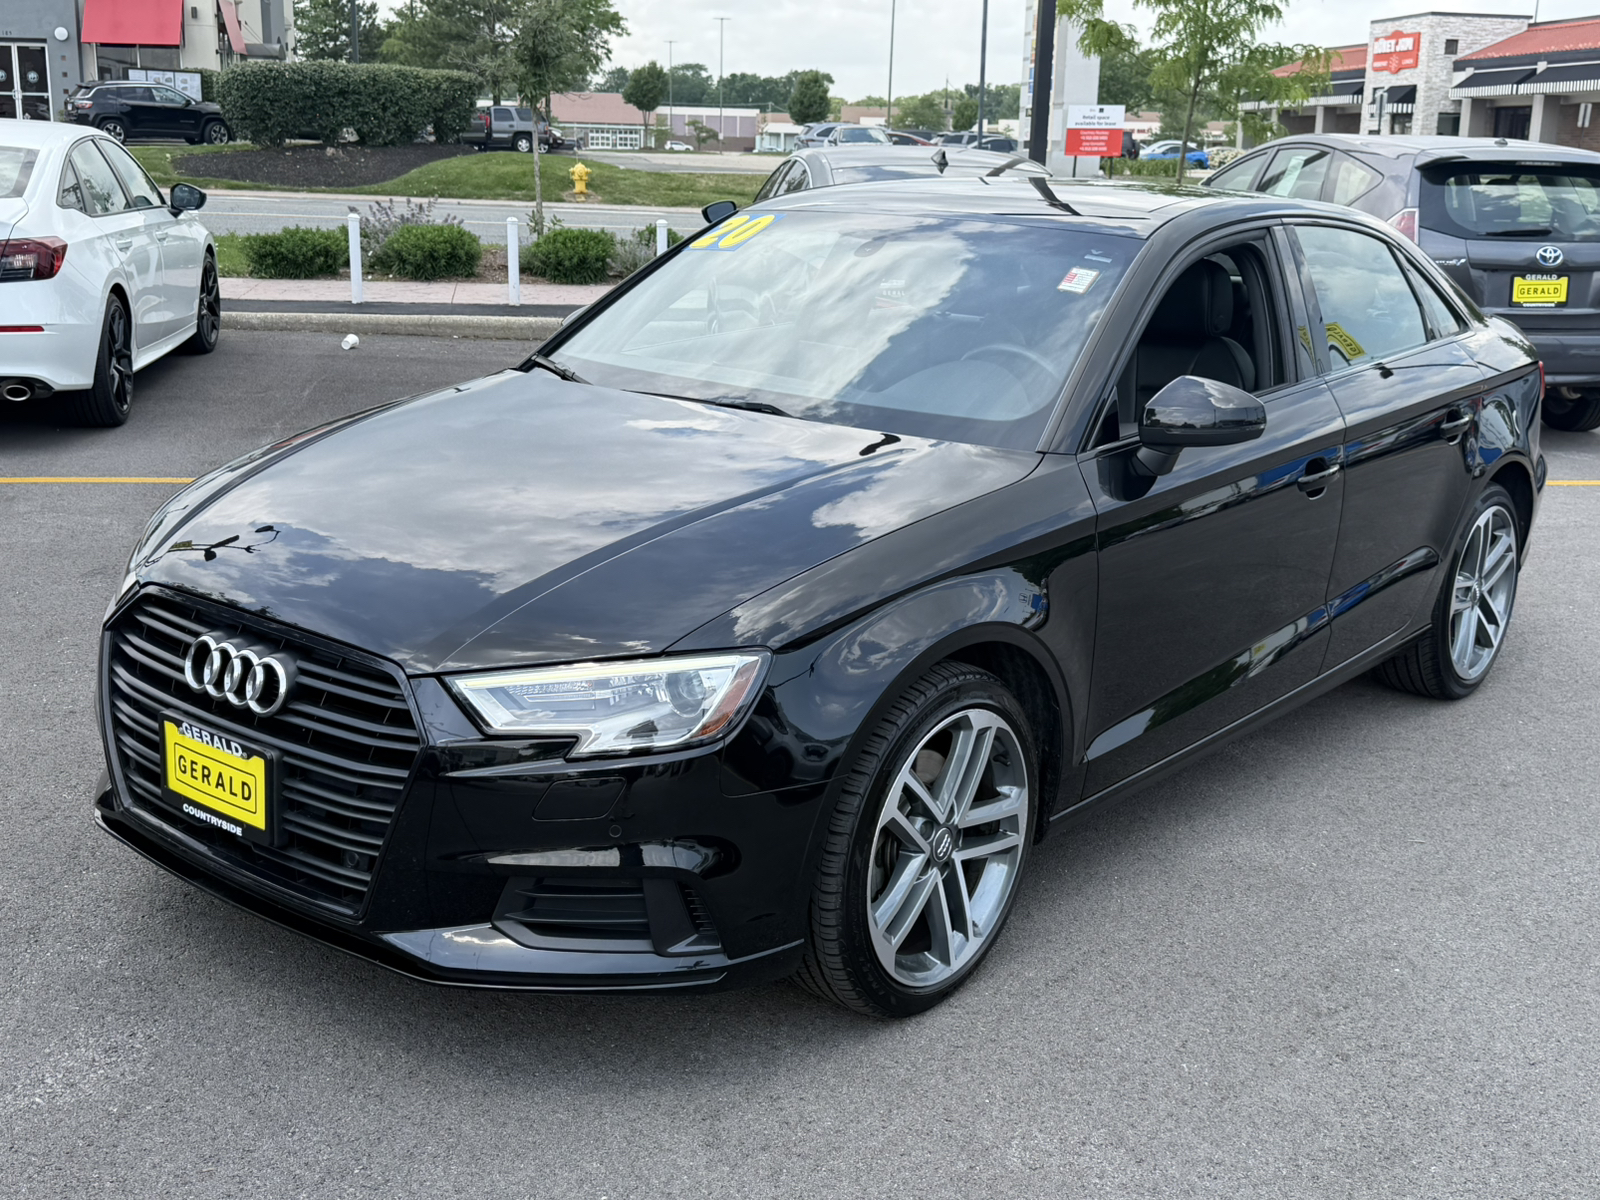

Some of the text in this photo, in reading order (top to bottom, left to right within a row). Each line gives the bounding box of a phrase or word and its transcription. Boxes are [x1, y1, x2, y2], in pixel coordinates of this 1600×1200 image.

[689, 214, 776, 249] 20
[1519, 287, 1559, 295] GERALD
[1525, 273, 1558, 281] GERALD
[181, 721, 243, 757] GERALD
[178, 754, 252, 801] GERALD
[182, 803, 243, 836] COUNTRYSIDE
